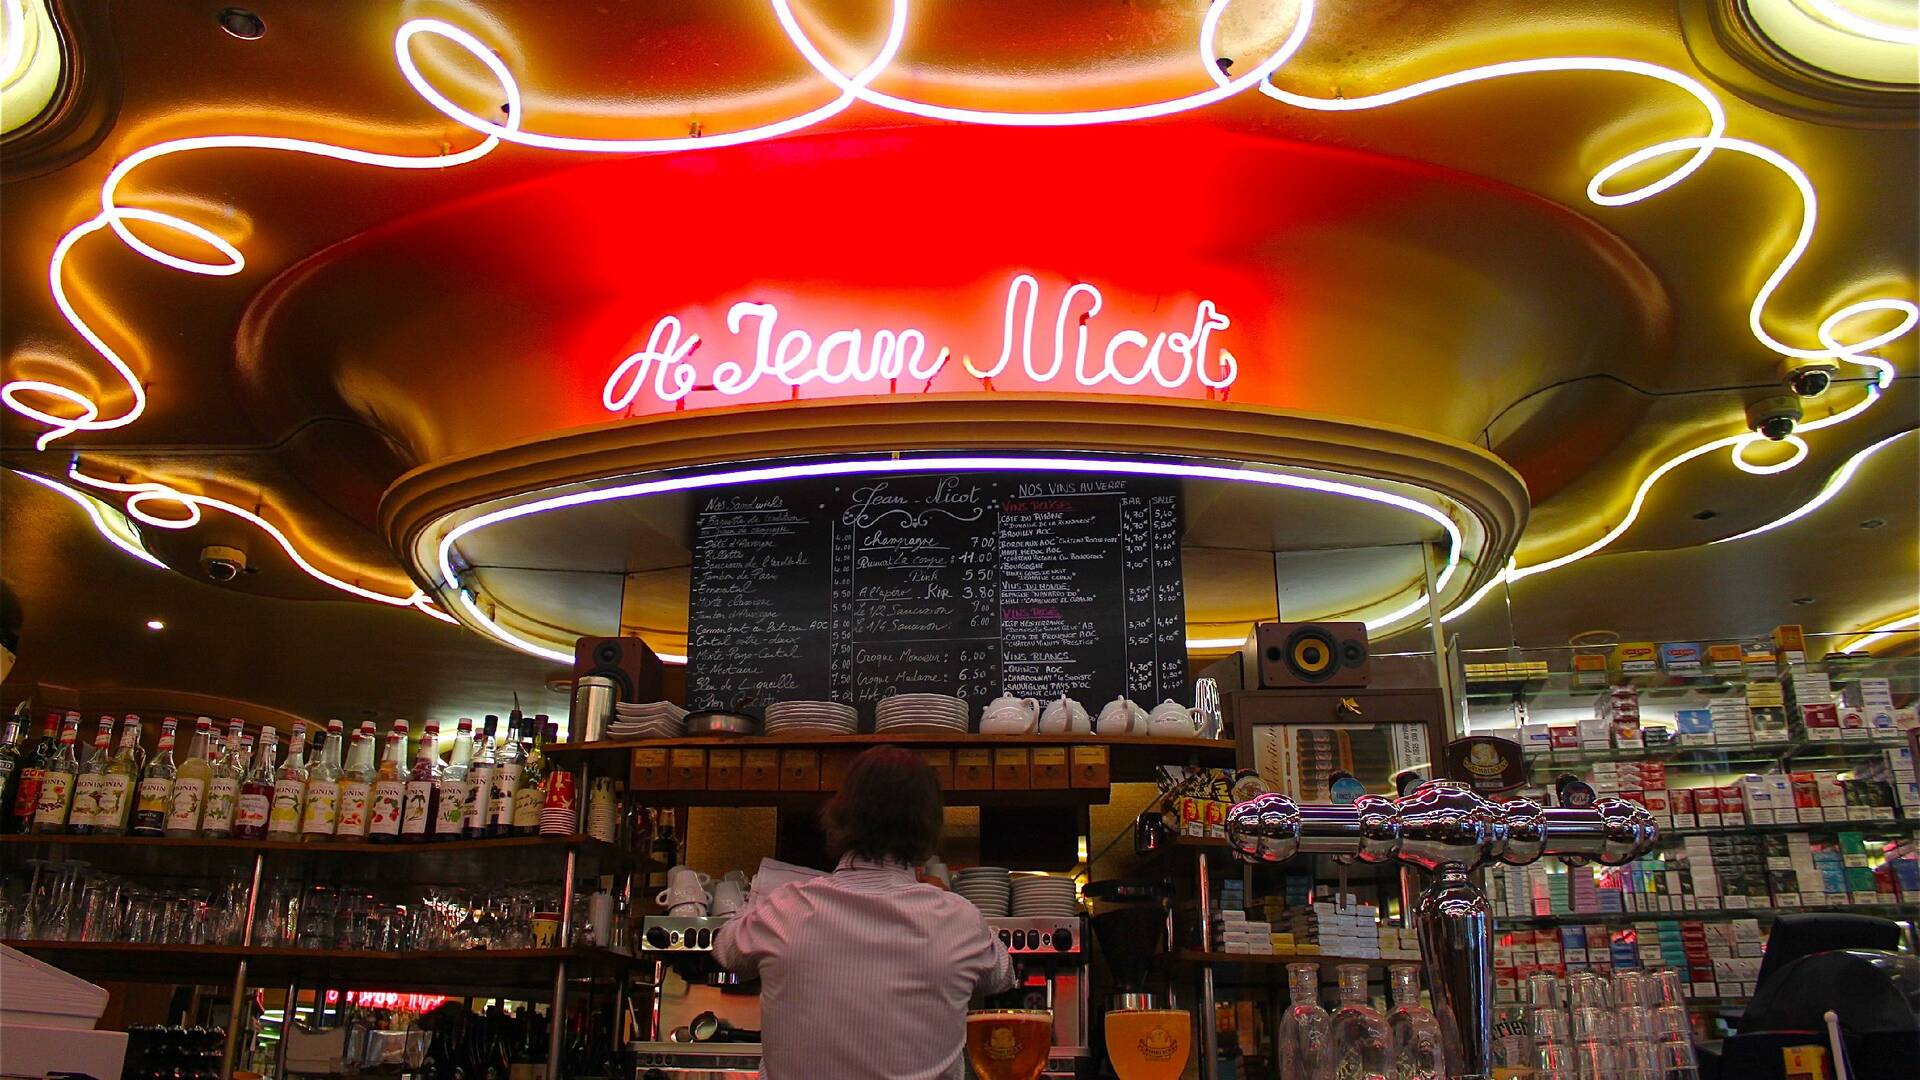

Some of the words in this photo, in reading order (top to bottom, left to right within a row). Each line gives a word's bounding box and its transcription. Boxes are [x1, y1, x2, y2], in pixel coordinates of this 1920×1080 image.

[712, 301, 950, 395] Jean
[964, 273, 1238, 390] Nicot
[1019, 483, 1043, 497] NOS
[1049, 481, 1076, 494] VINS
[1080, 481, 1094, 493] AU
[1095, 480, 1127, 491] VERRE
[843, 482, 908, 525] Jean
[926, 477, 981, 504] Nicot
[1120, 497, 1142, 506] BAR
[1151, 496, 1176, 504] SALLE
[962, 586, 995, 599] 3.80
[808, 619, 829, 632] AOC
[1004, 652, 1027, 661] VINS
[1032, 651, 1070, 661] BLANCS
[958, 668, 987, 681] 6.50
[1046, 665, 1064, 673] AOC
[44, 778, 67, 787] ONIN
[210, 784, 232, 792] ONIN
